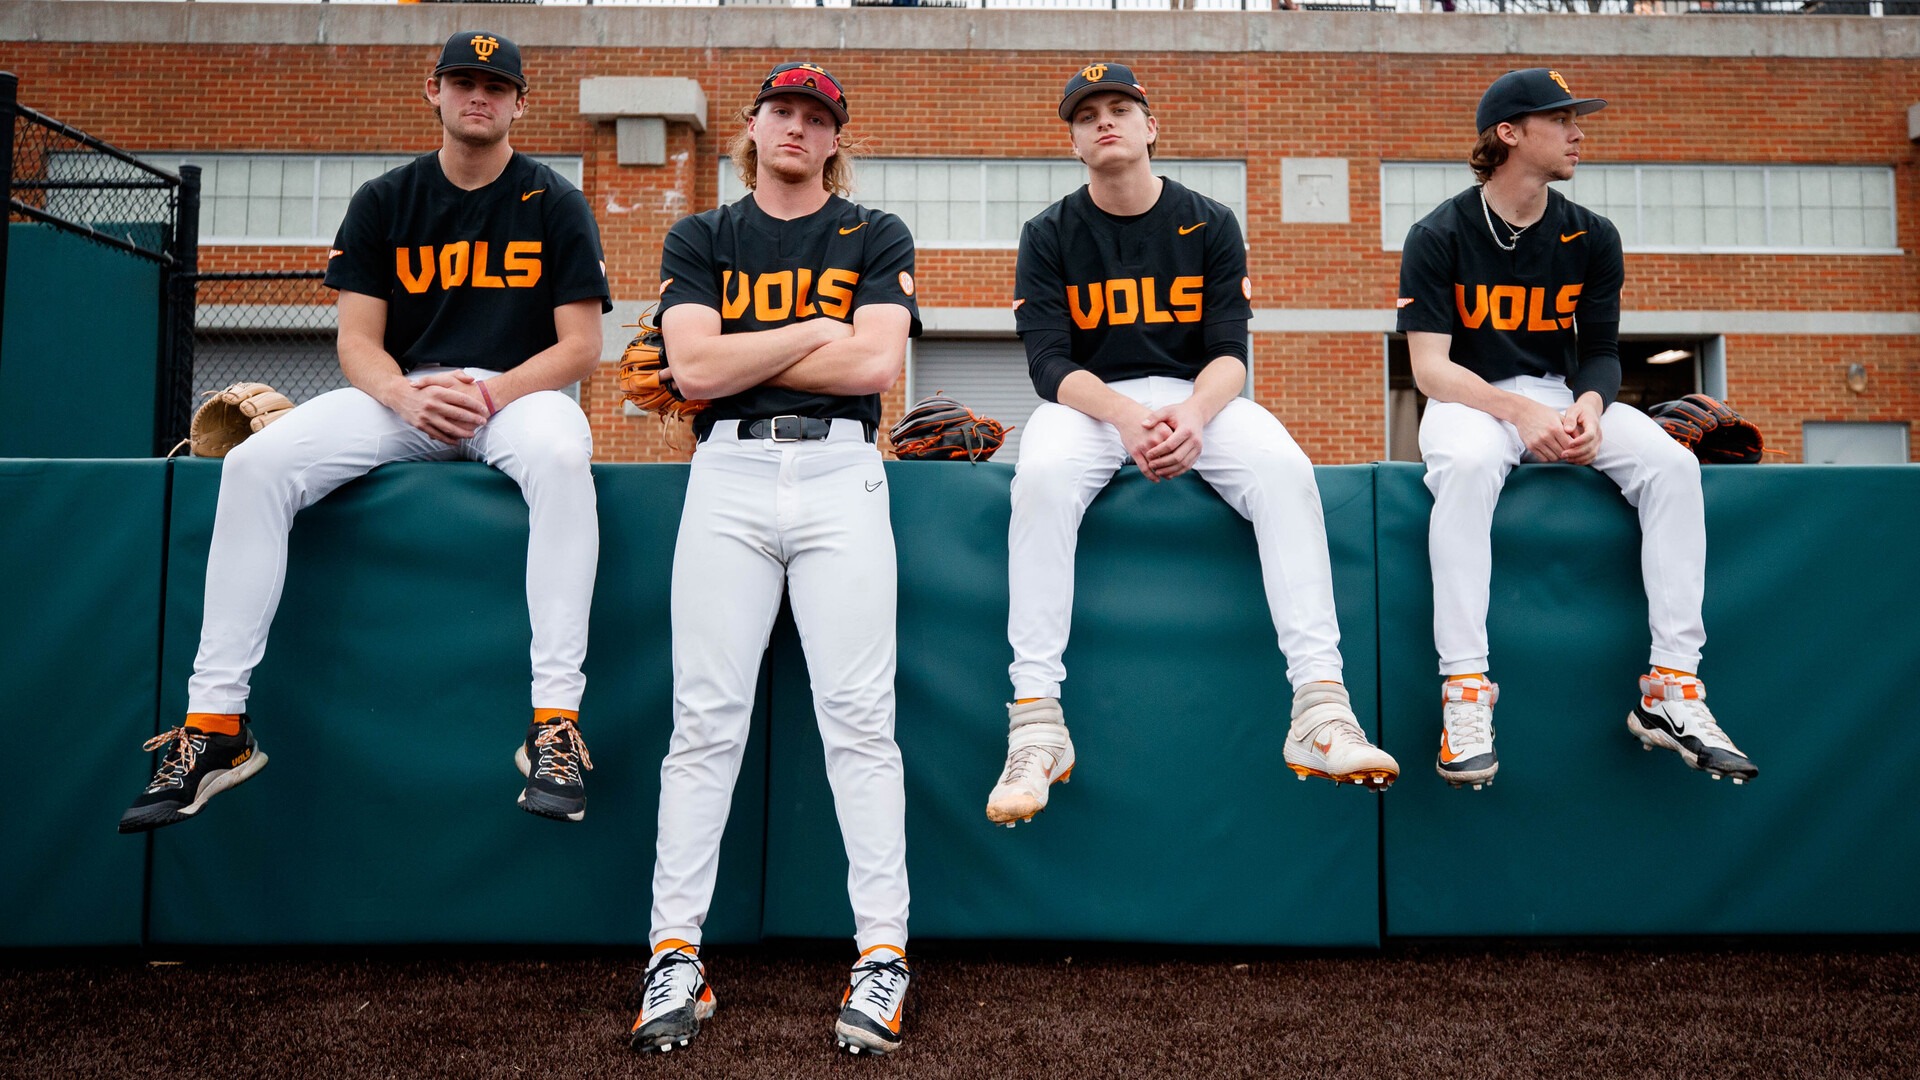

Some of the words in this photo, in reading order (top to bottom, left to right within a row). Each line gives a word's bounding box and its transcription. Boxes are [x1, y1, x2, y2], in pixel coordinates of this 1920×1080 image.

[397, 241, 541, 294] VOLS
[722, 267, 860, 322] VOLS
[1066, 275, 1204, 330] VOLS
[1455, 283, 1584, 332] VOLS
[231, 748, 251, 767] VOLS
